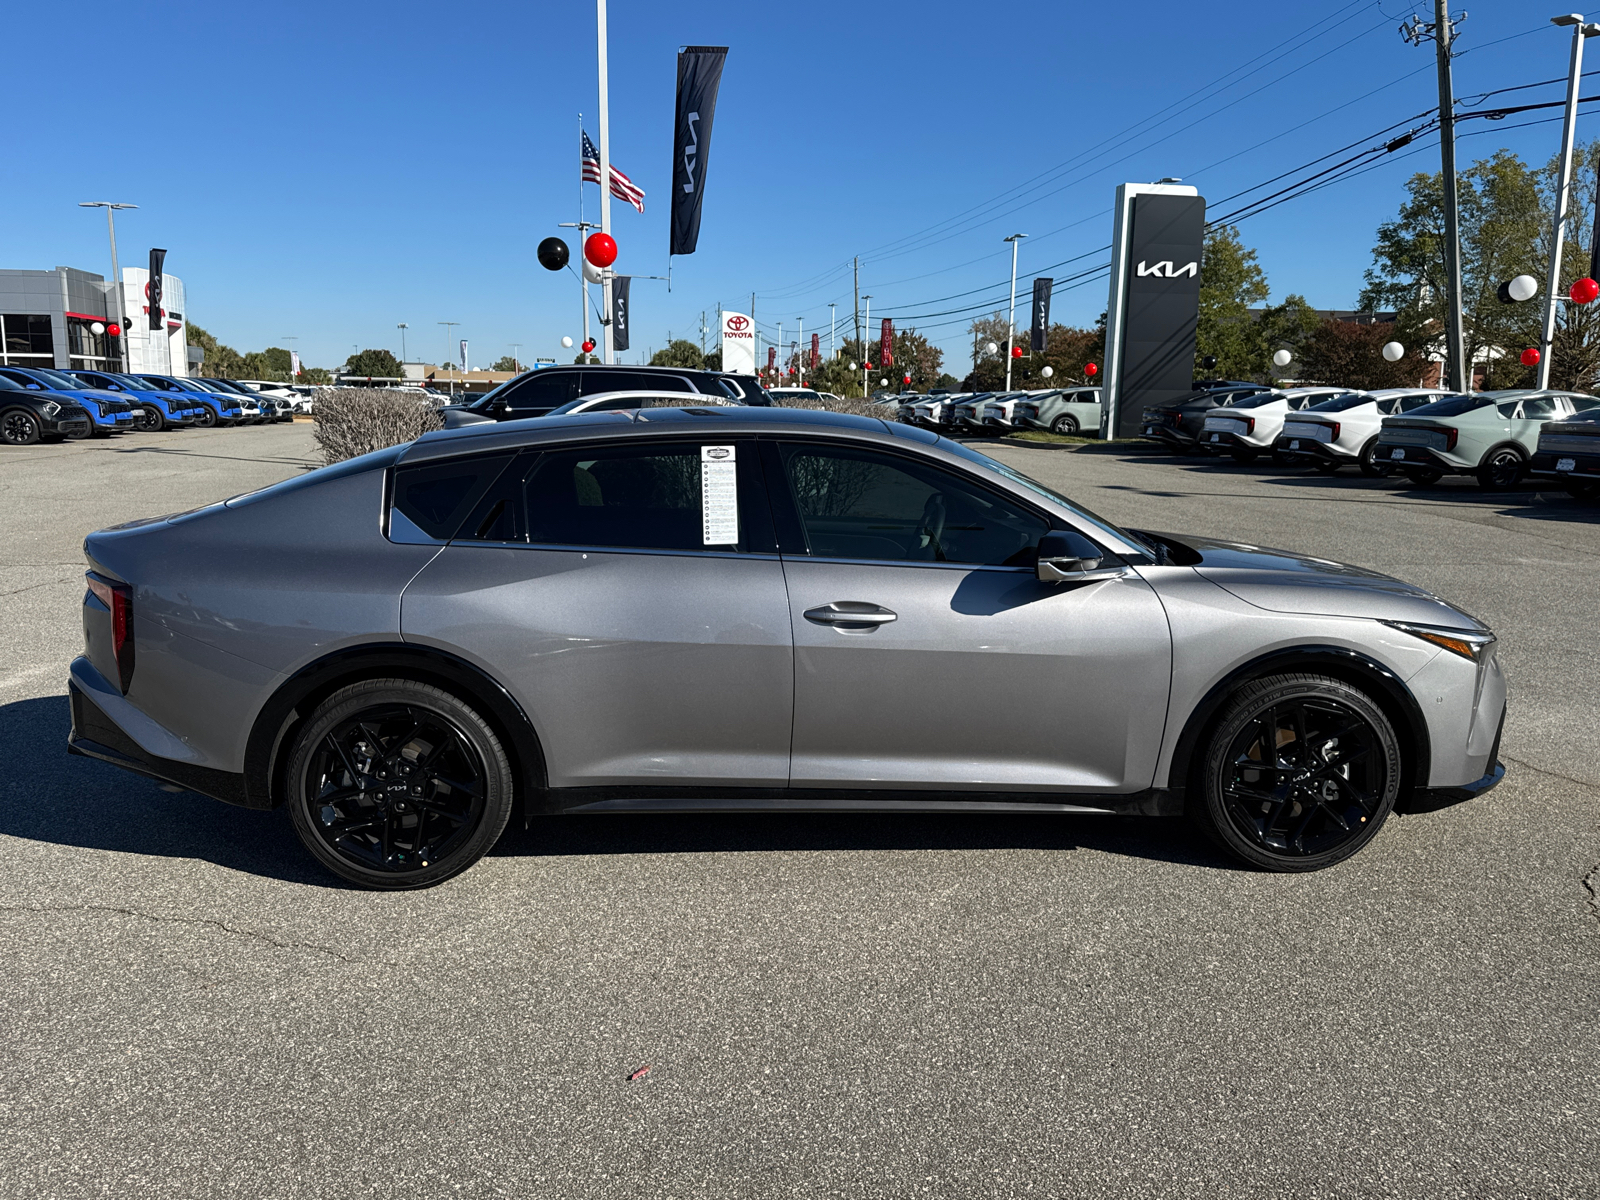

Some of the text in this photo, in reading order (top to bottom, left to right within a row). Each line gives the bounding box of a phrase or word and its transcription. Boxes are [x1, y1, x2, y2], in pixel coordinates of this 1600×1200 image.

[682, 111, 700, 193] KIA
[1137, 260, 1198, 278] KIA
[617, 298, 625, 329] KIA
[723, 331, 753, 339] TOYOTA
[310, 699, 359, 737] KUMHO
[1292, 771, 1311, 782] KIA
[1387, 743, 1396, 794] KUMHO
